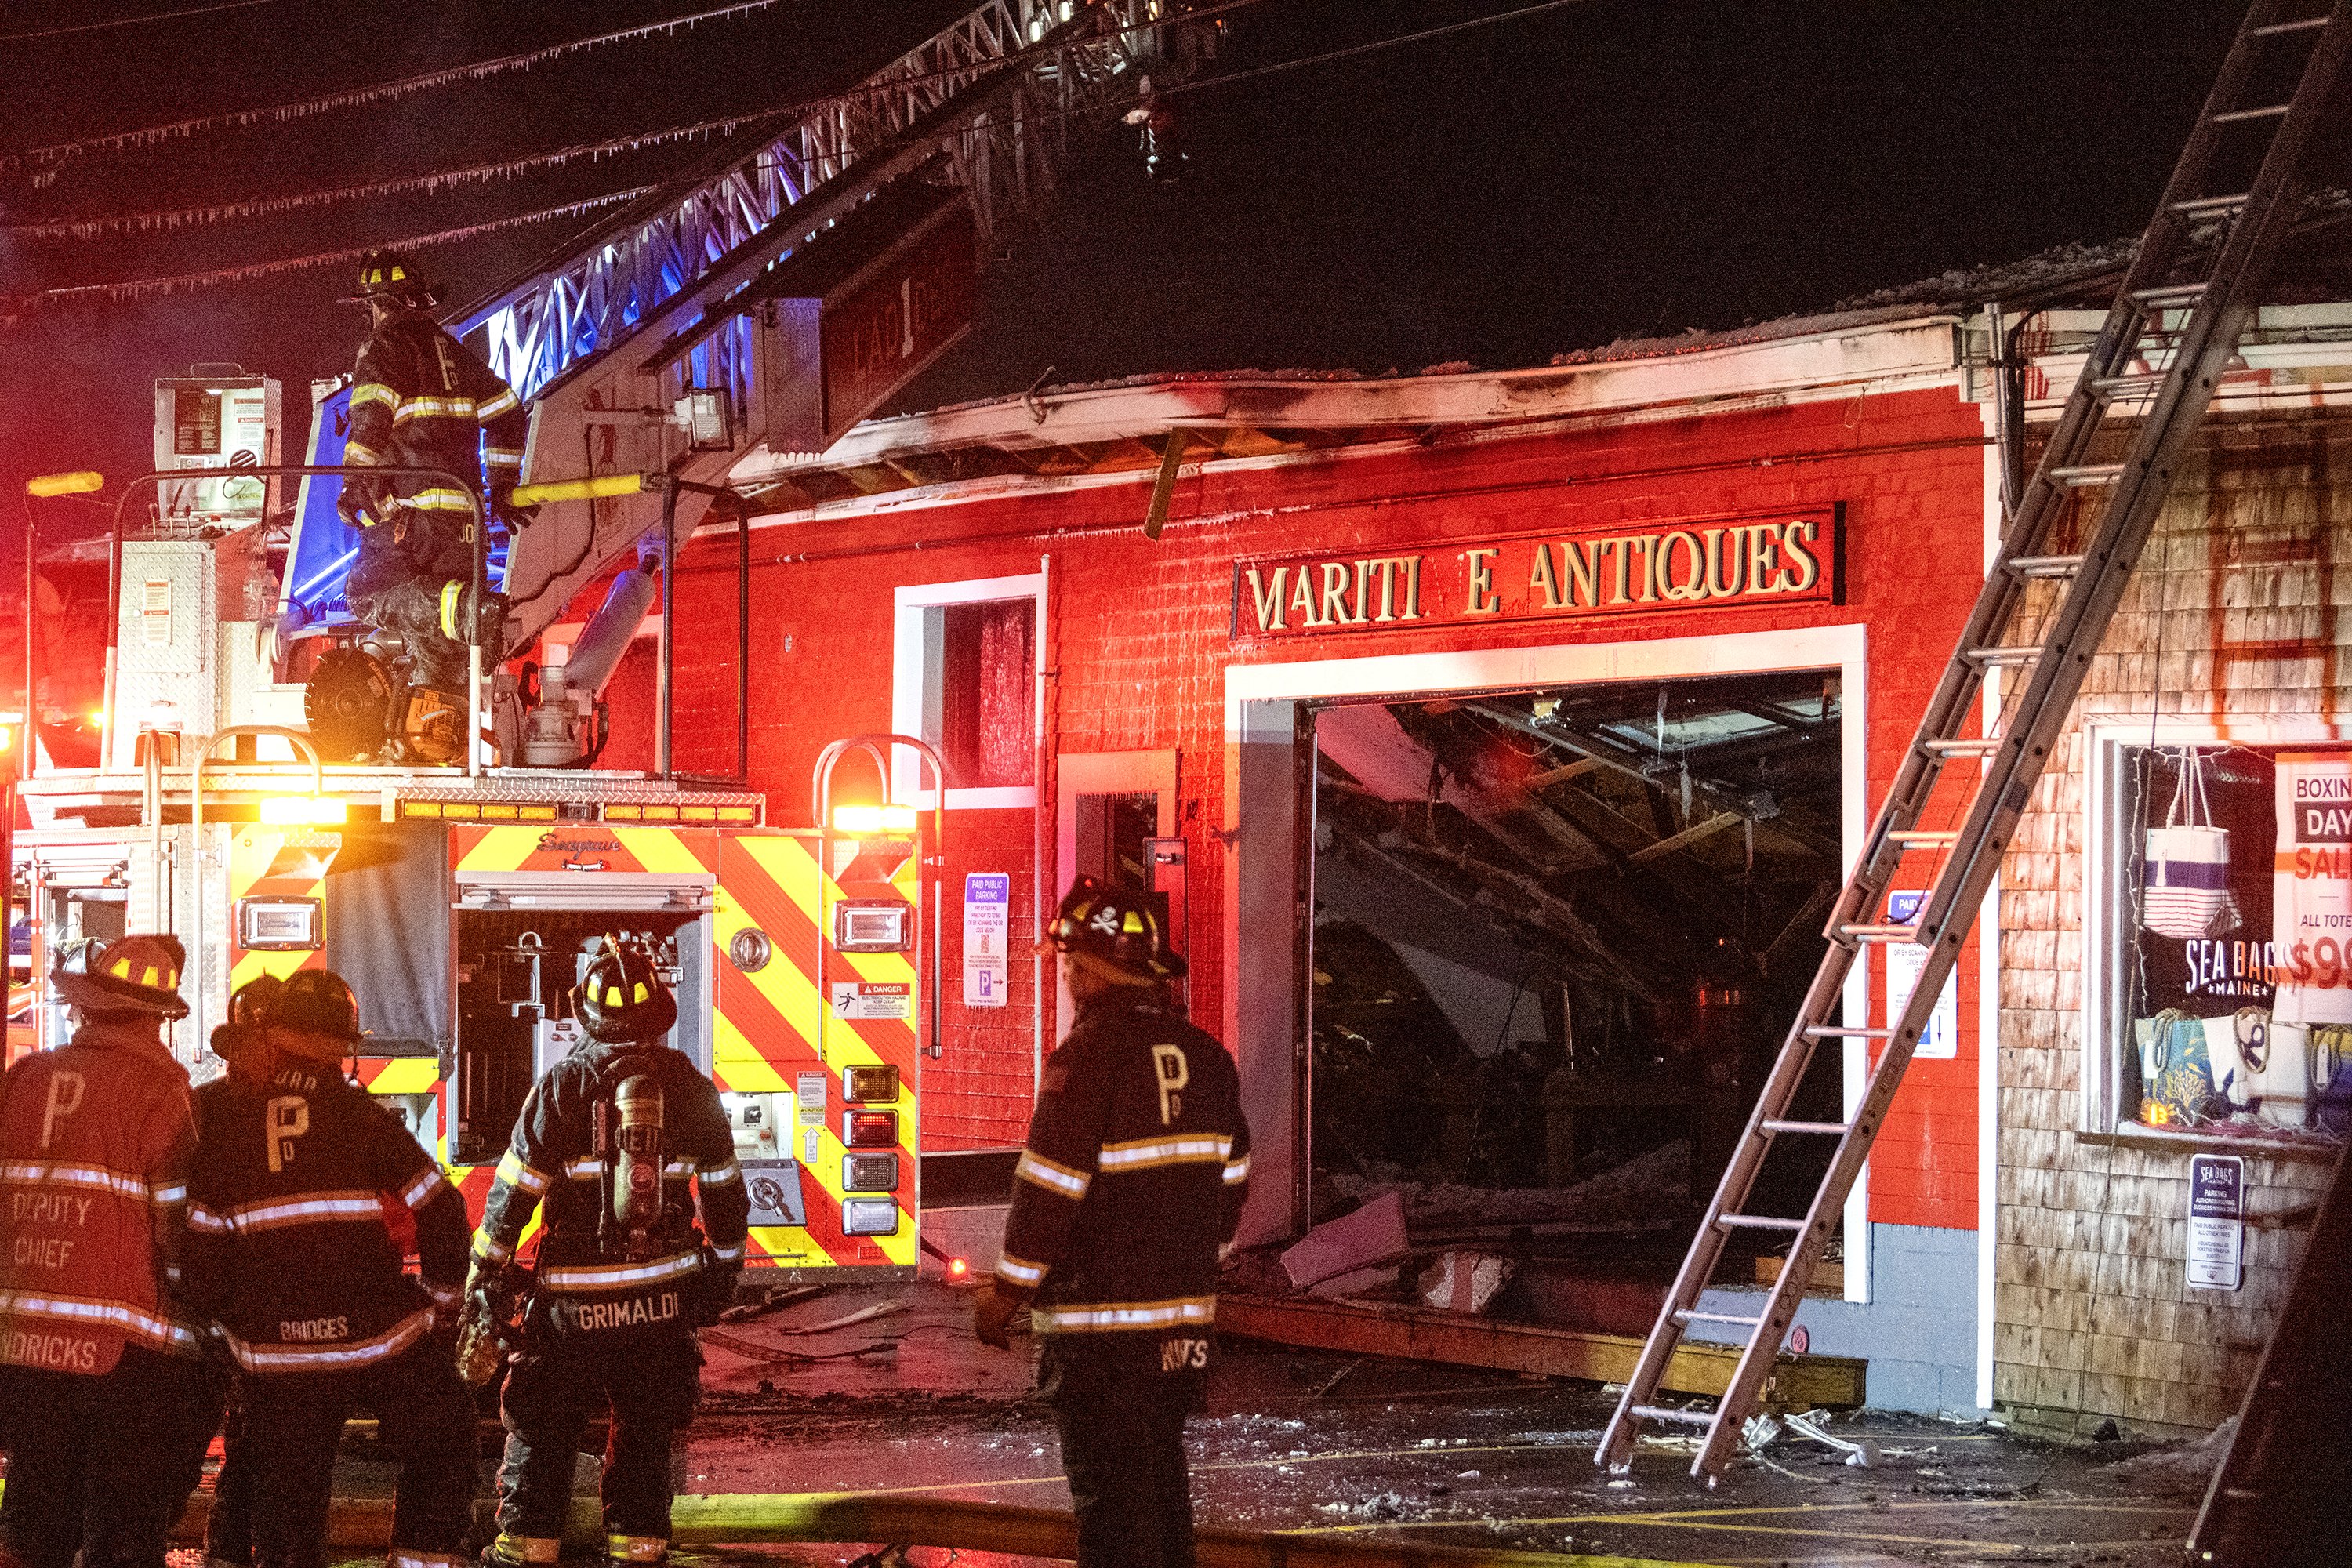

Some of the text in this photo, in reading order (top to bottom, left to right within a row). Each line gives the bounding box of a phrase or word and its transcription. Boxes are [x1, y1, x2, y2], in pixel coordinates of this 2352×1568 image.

[1530, 521, 1820, 609] ANTIQUES
[2307, 809, 2352, 835] DAY
[536, 833, 619, 860] Seagrave
[2295, 847, 2352, 879] SAL
[972, 880, 1003, 889] PAID PUBLIC
[975, 891, 997, 900] PARKING
[1898, 899, 1916, 910] PAID
[2300, 914, 2321, 927] ALL
[2185, 938, 2225, 993] SEA
[982, 973, 989, 994] P
[2216, 982, 2260, 996] MAINE
[1151, 1044, 1189, 1125] P
[41, 1070, 85, 1149] P
[267, 1096, 309, 1172] P
[2201, 1167, 2233, 1185] SEA BAGS
[13, 1192, 91, 1225] DEPUTY
[13, 1238, 74, 1269] CHIEF
[579, 1291, 679, 1330] GRIMALDI
[280, 1316, 348, 1341] BRIDGES
